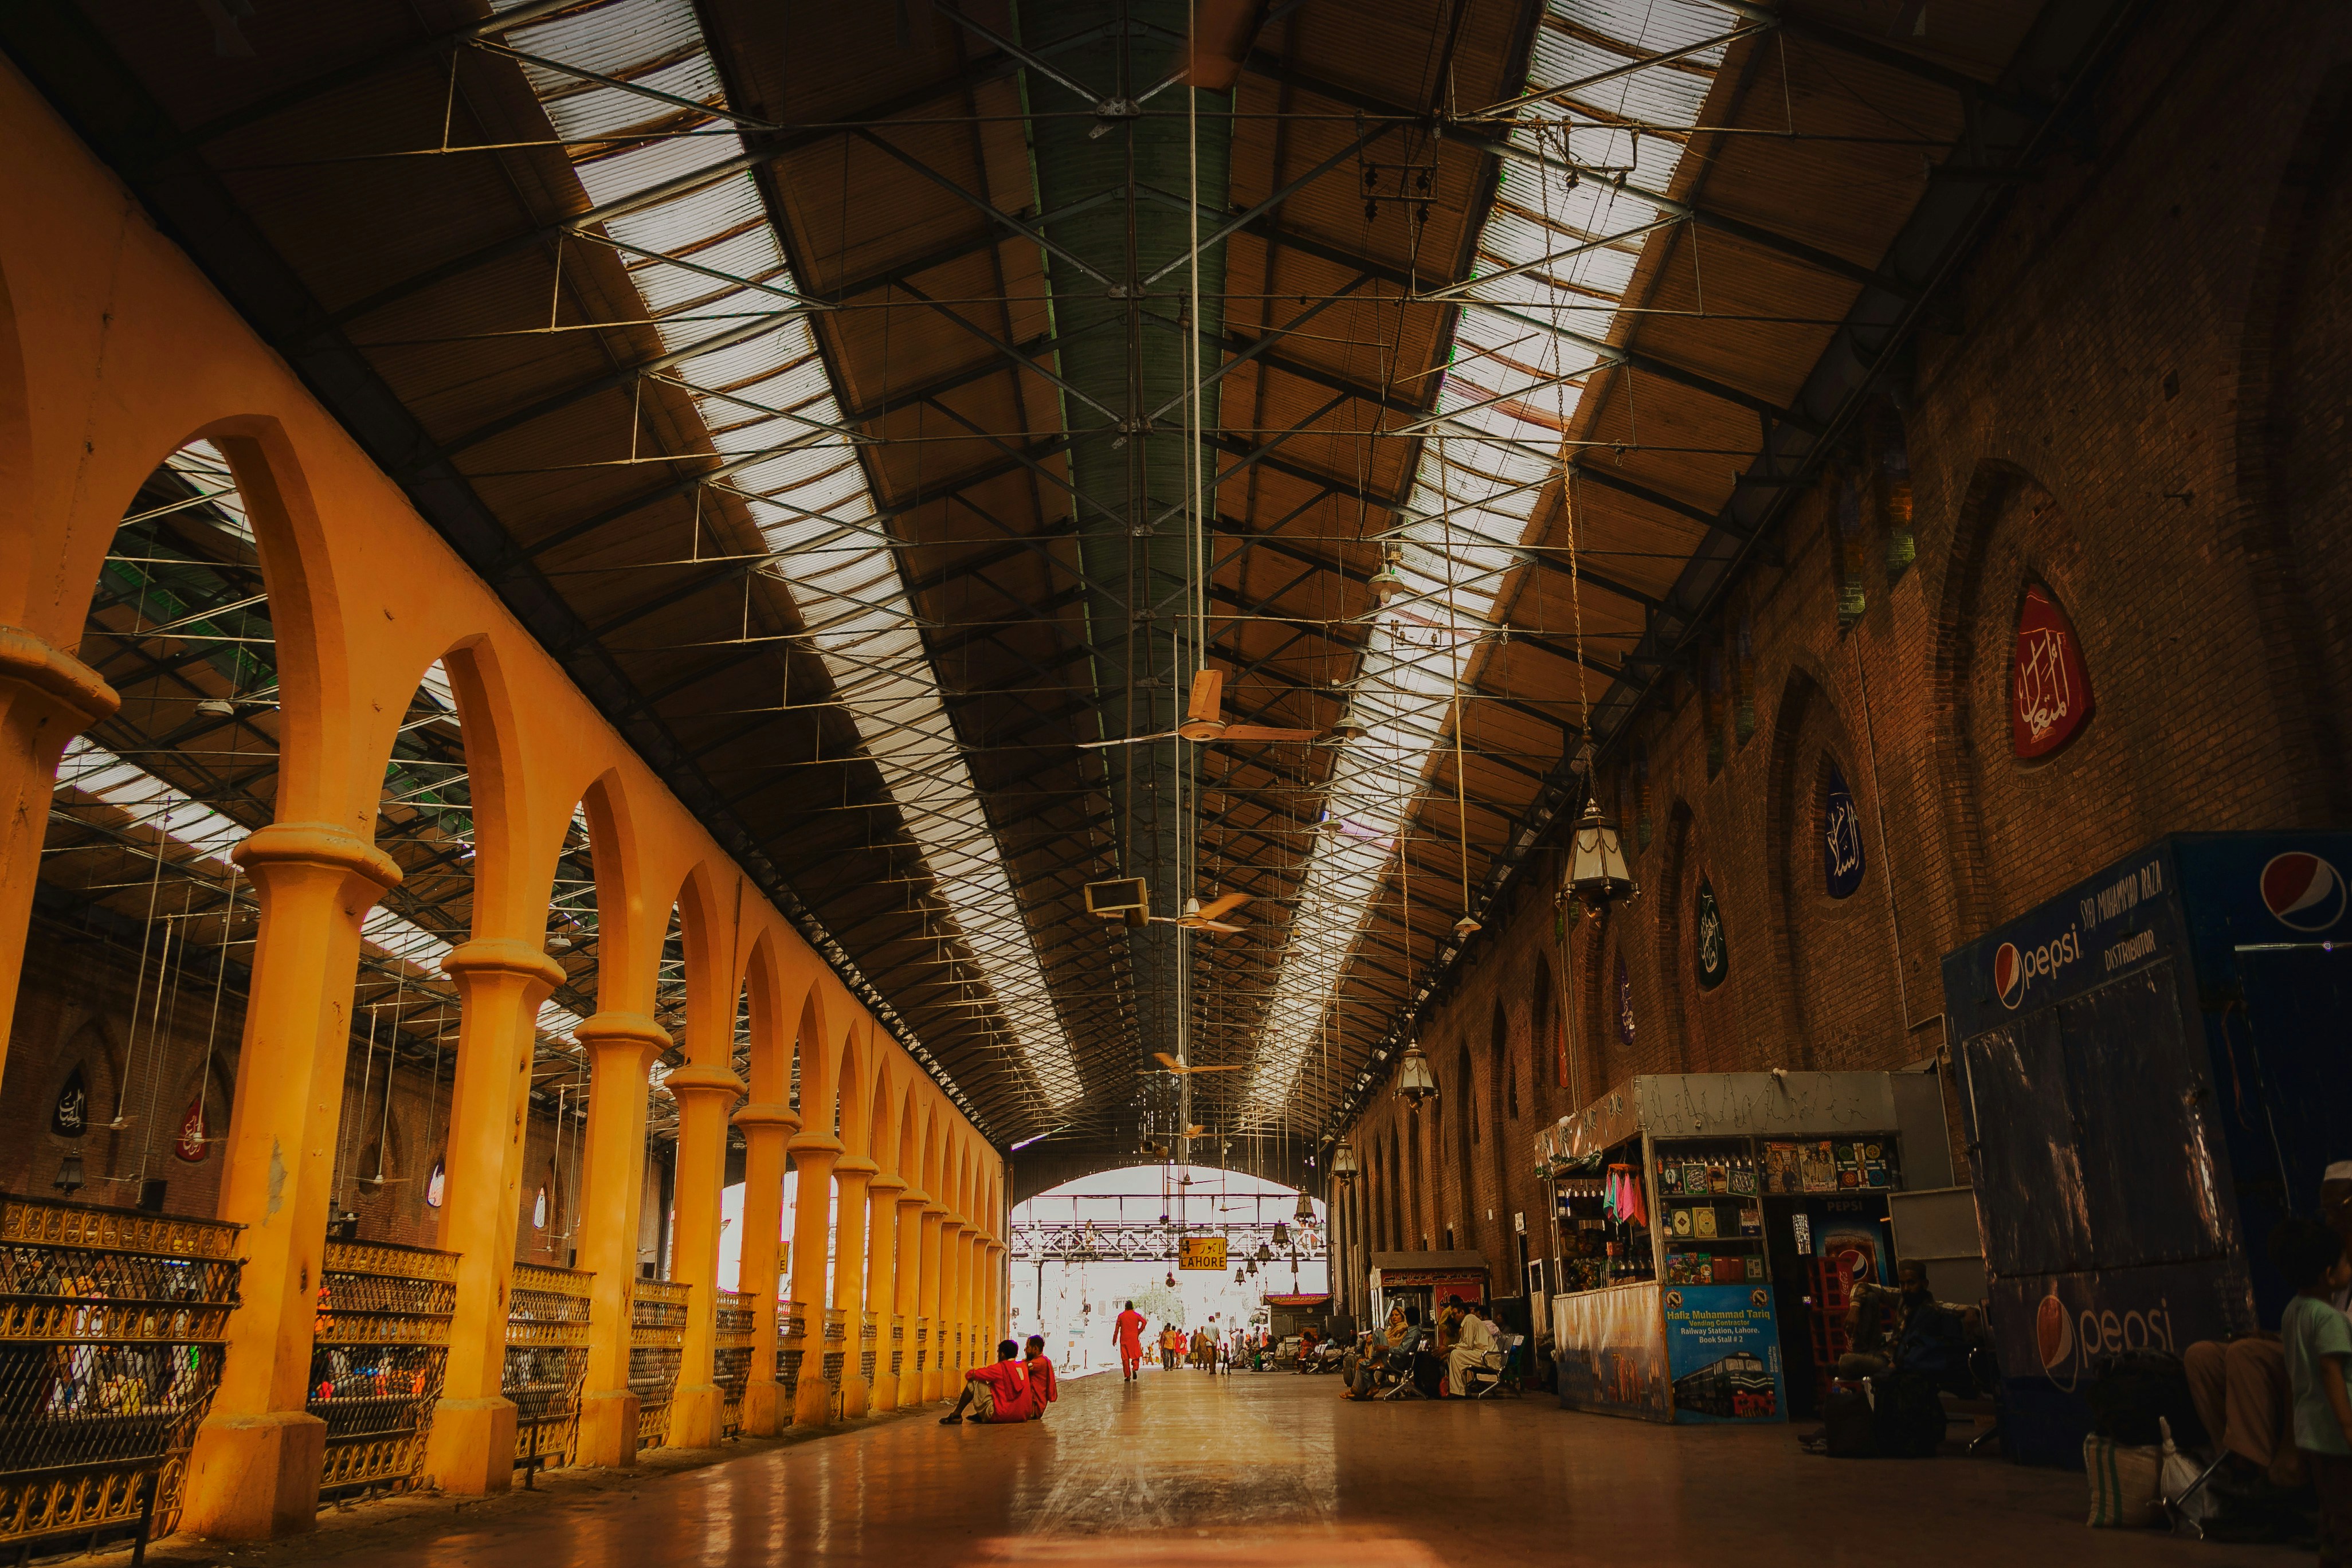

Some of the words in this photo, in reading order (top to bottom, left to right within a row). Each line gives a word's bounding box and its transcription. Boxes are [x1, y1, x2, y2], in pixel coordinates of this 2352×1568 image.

[2080, 897, 2096, 932] SYED
[2098, 873, 2138, 923] MUHAMMAD
[2141, 860, 2162, 900] RAZA
[2024, 923, 2080, 990] pepsi
[2104, 929, 2157, 971] DISTRIBUTOR
[1826, 1201, 1863, 1212] PEPSI
[1181, 1256, 1225, 1267] LAHORE
[1667, 1311, 1690, 1320] Hafiz
[1692, 1310, 1745, 1320] Muhammad
[1746, 1310, 1770, 1320] Tariq
